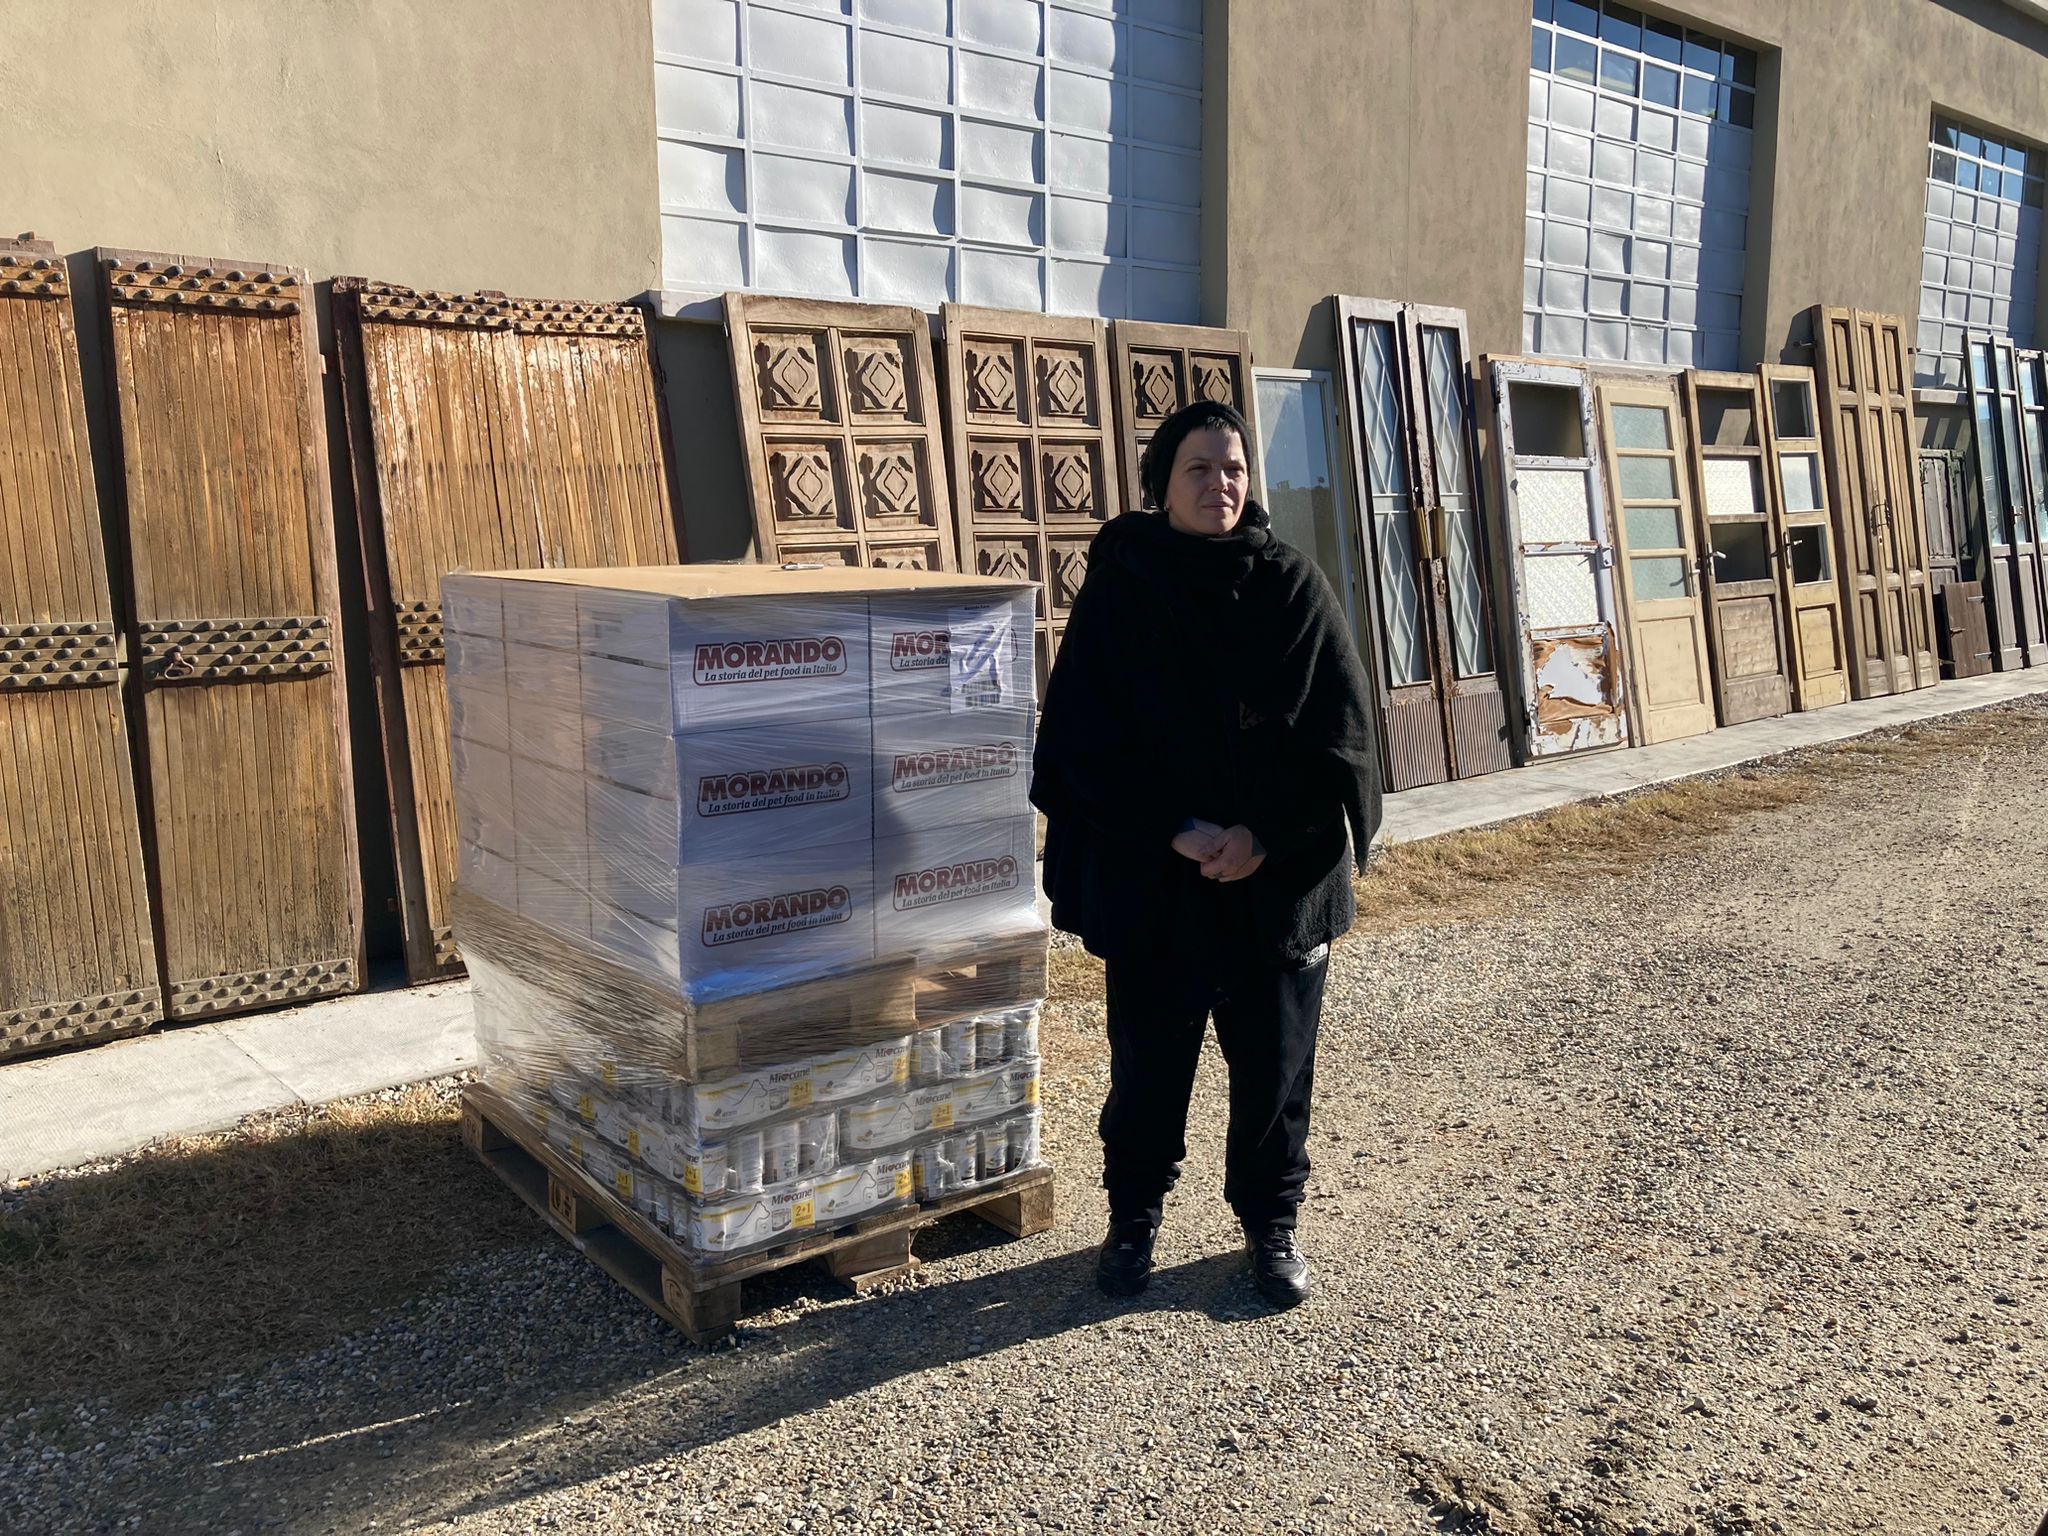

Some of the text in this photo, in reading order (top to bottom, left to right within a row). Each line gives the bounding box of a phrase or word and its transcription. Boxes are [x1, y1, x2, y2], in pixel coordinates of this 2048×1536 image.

[697, 640, 842, 671] MORANDO
[900, 658, 911, 668] La
[911, 657, 935, 667] storia
[704, 663, 837, 682] La storia del pet food in Italia
[895, 745, 1014, 779] MORANDO
[701, 765, 845, 802] MORANDO
[901, 779, 912, 789] La
[912, 776, 936, 788] storia
[936, 774, 949, 785] del
[949, 772, 963, 785] pet
[708, 803, 720, 813] La
[721, 800, 750, 812] storia
[752, 798, 767, 809] del
[767, 796, 783, 810] pet
[783, 792, 804, 807] food
[805, 791, 815, 800] in
[896, 858, 1014, 898] MORANDO
[902, 898, 913, 908] La
[913, 894, 937, 906] storia
[938, 889, 950, 901] del
[950, 888, 963, 901] pet
[990, 879, 1011, 891] Italia
[706, 888, 848, 933] MORANDO
[712, 932, 725, 943] La
[726, 928, 754, 941] storia
[755, 924, 770, 937] del
[770, 922, 786, 936] pet
[786, 917, 807, 933] food
[793, 1081, 809, 1097] 2+1
[795, 1202, 811, 1217] 2+1
